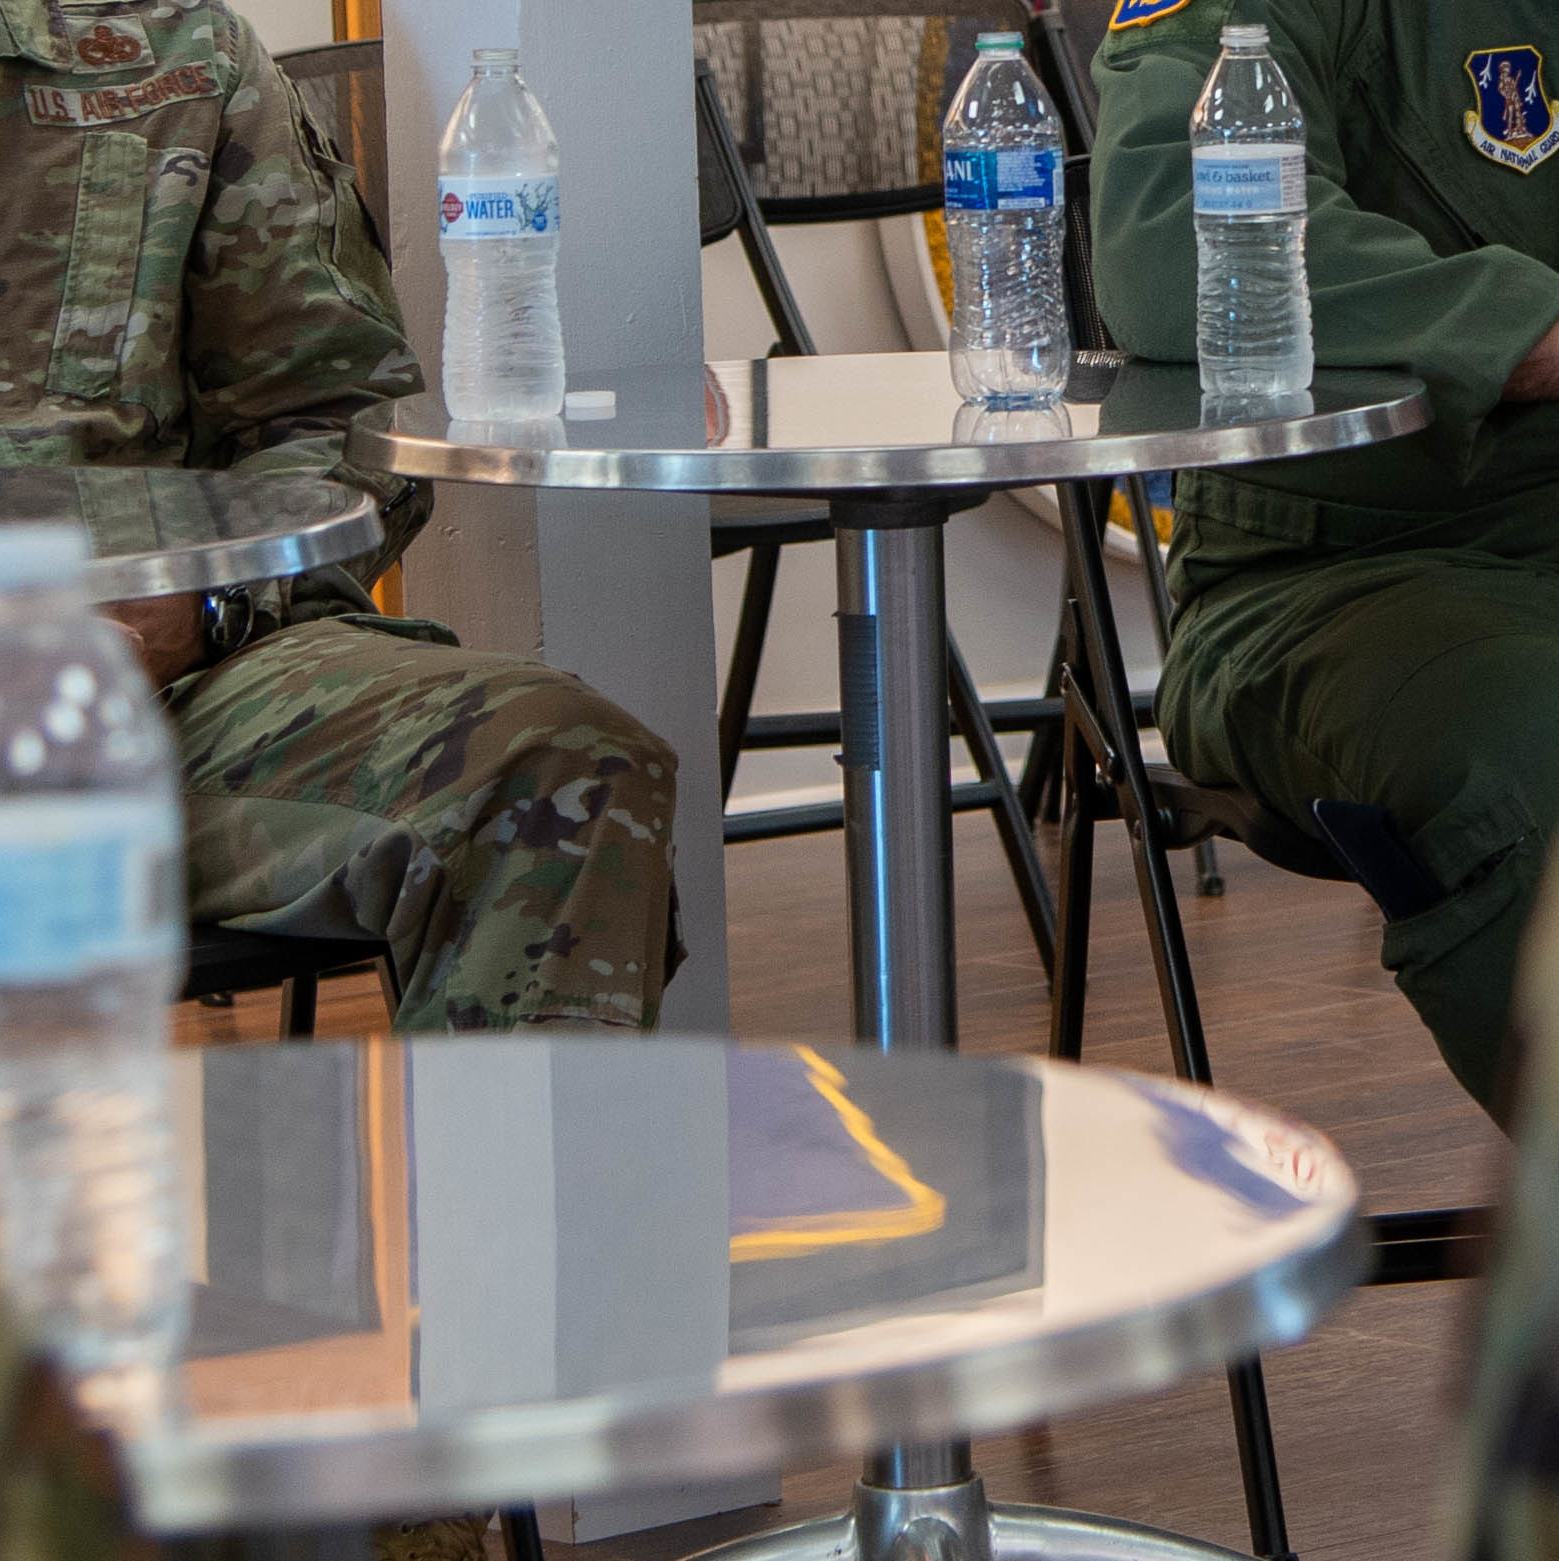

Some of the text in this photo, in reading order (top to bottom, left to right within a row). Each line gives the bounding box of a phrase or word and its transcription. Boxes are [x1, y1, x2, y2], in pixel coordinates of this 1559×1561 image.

[30, 64, 215, 123] U.S. AIR FORCE
[1480, 140, 1496, 157] AIR
[1500, 148, 1539, 170] NATIONAL
[465, 199, 515, 220] WATER
